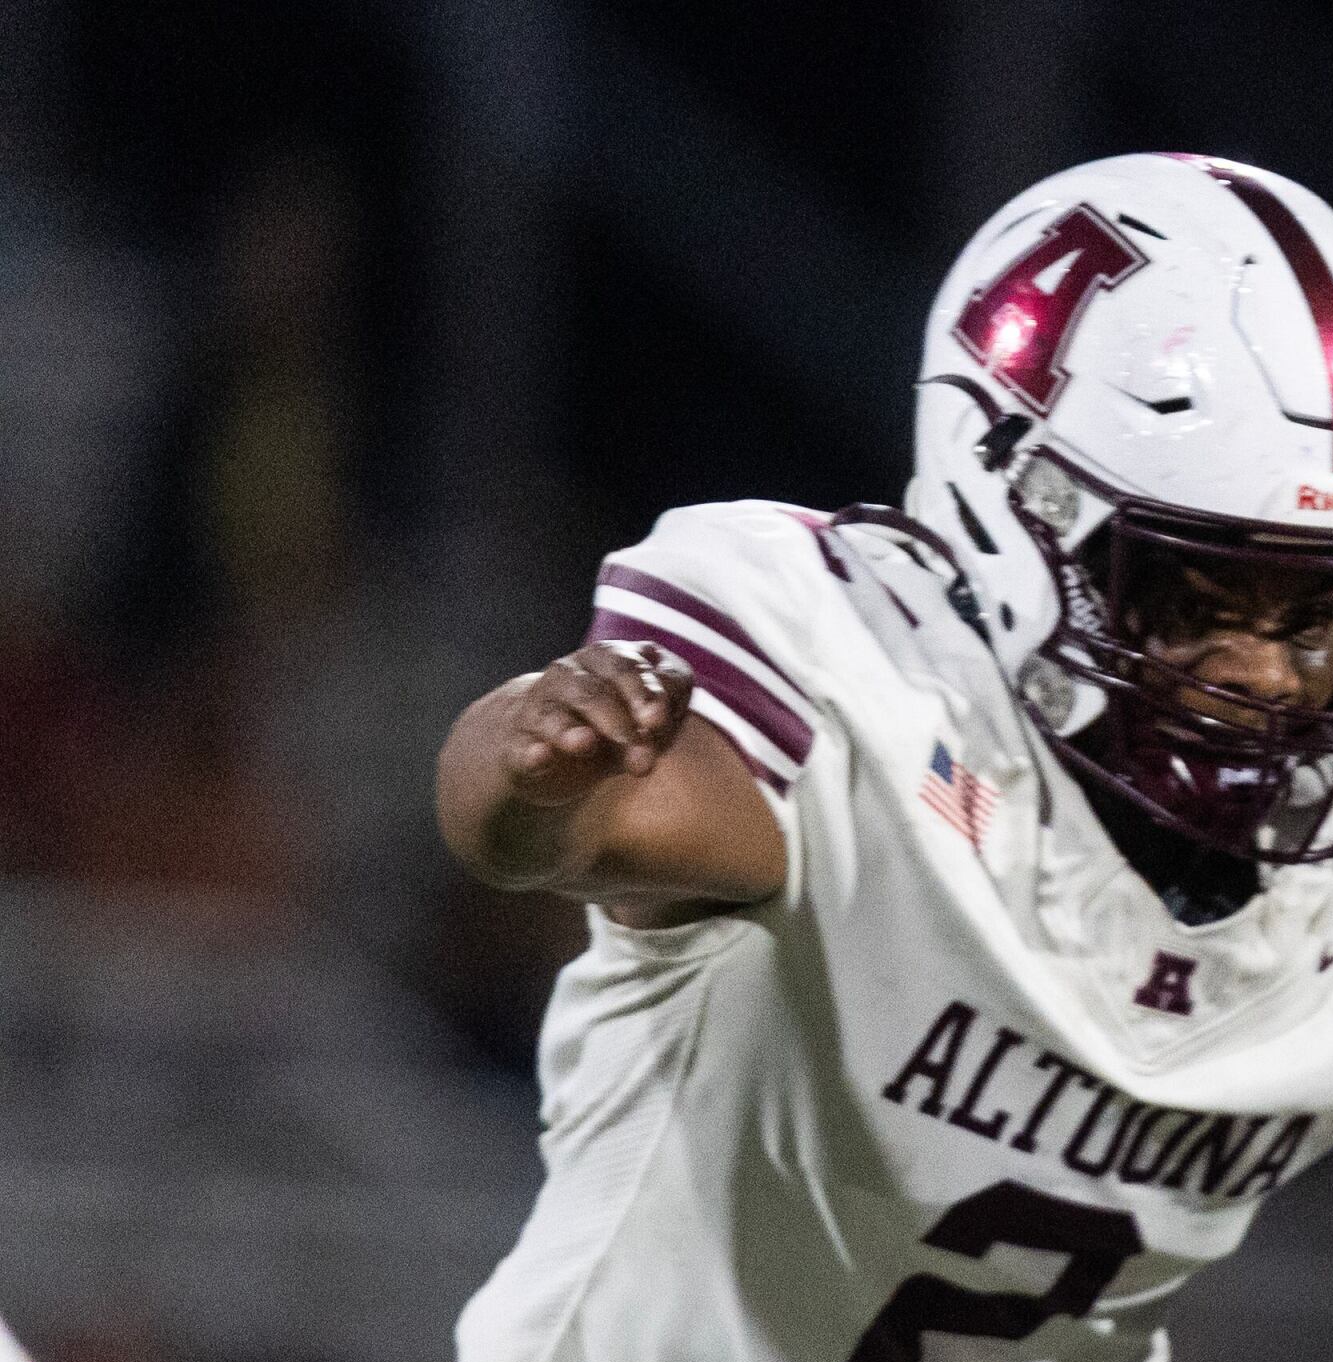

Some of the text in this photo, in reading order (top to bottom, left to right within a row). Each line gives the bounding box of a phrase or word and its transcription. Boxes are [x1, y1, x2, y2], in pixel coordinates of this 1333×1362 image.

[953, 203, 1150, 420] A
[1133, 949, 1198, 1016] A
[881, 1001, 1317, 1198] ALTOONA
